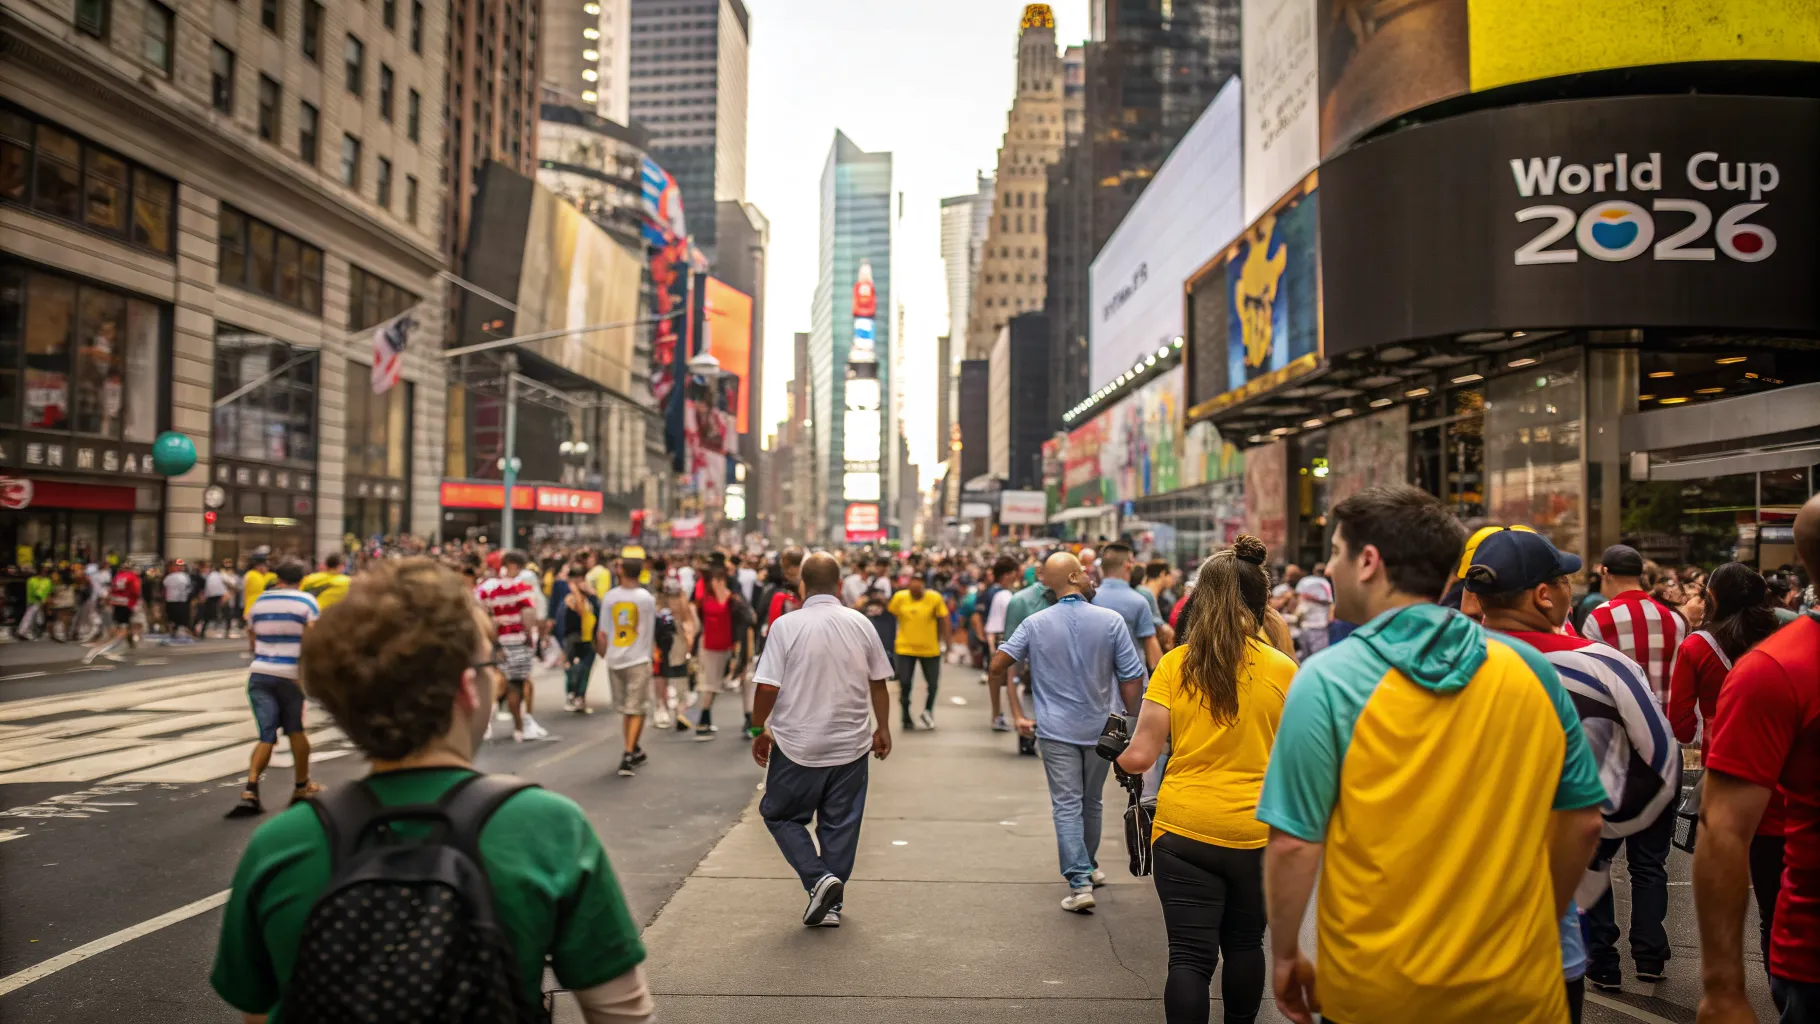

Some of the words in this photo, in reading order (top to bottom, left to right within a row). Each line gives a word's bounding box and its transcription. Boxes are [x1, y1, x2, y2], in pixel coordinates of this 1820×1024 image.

[1509, 152, 1662, 197] World
[1686, 151, 1780, 201] Cup
[1514, 198, 1777, 266] 2026
